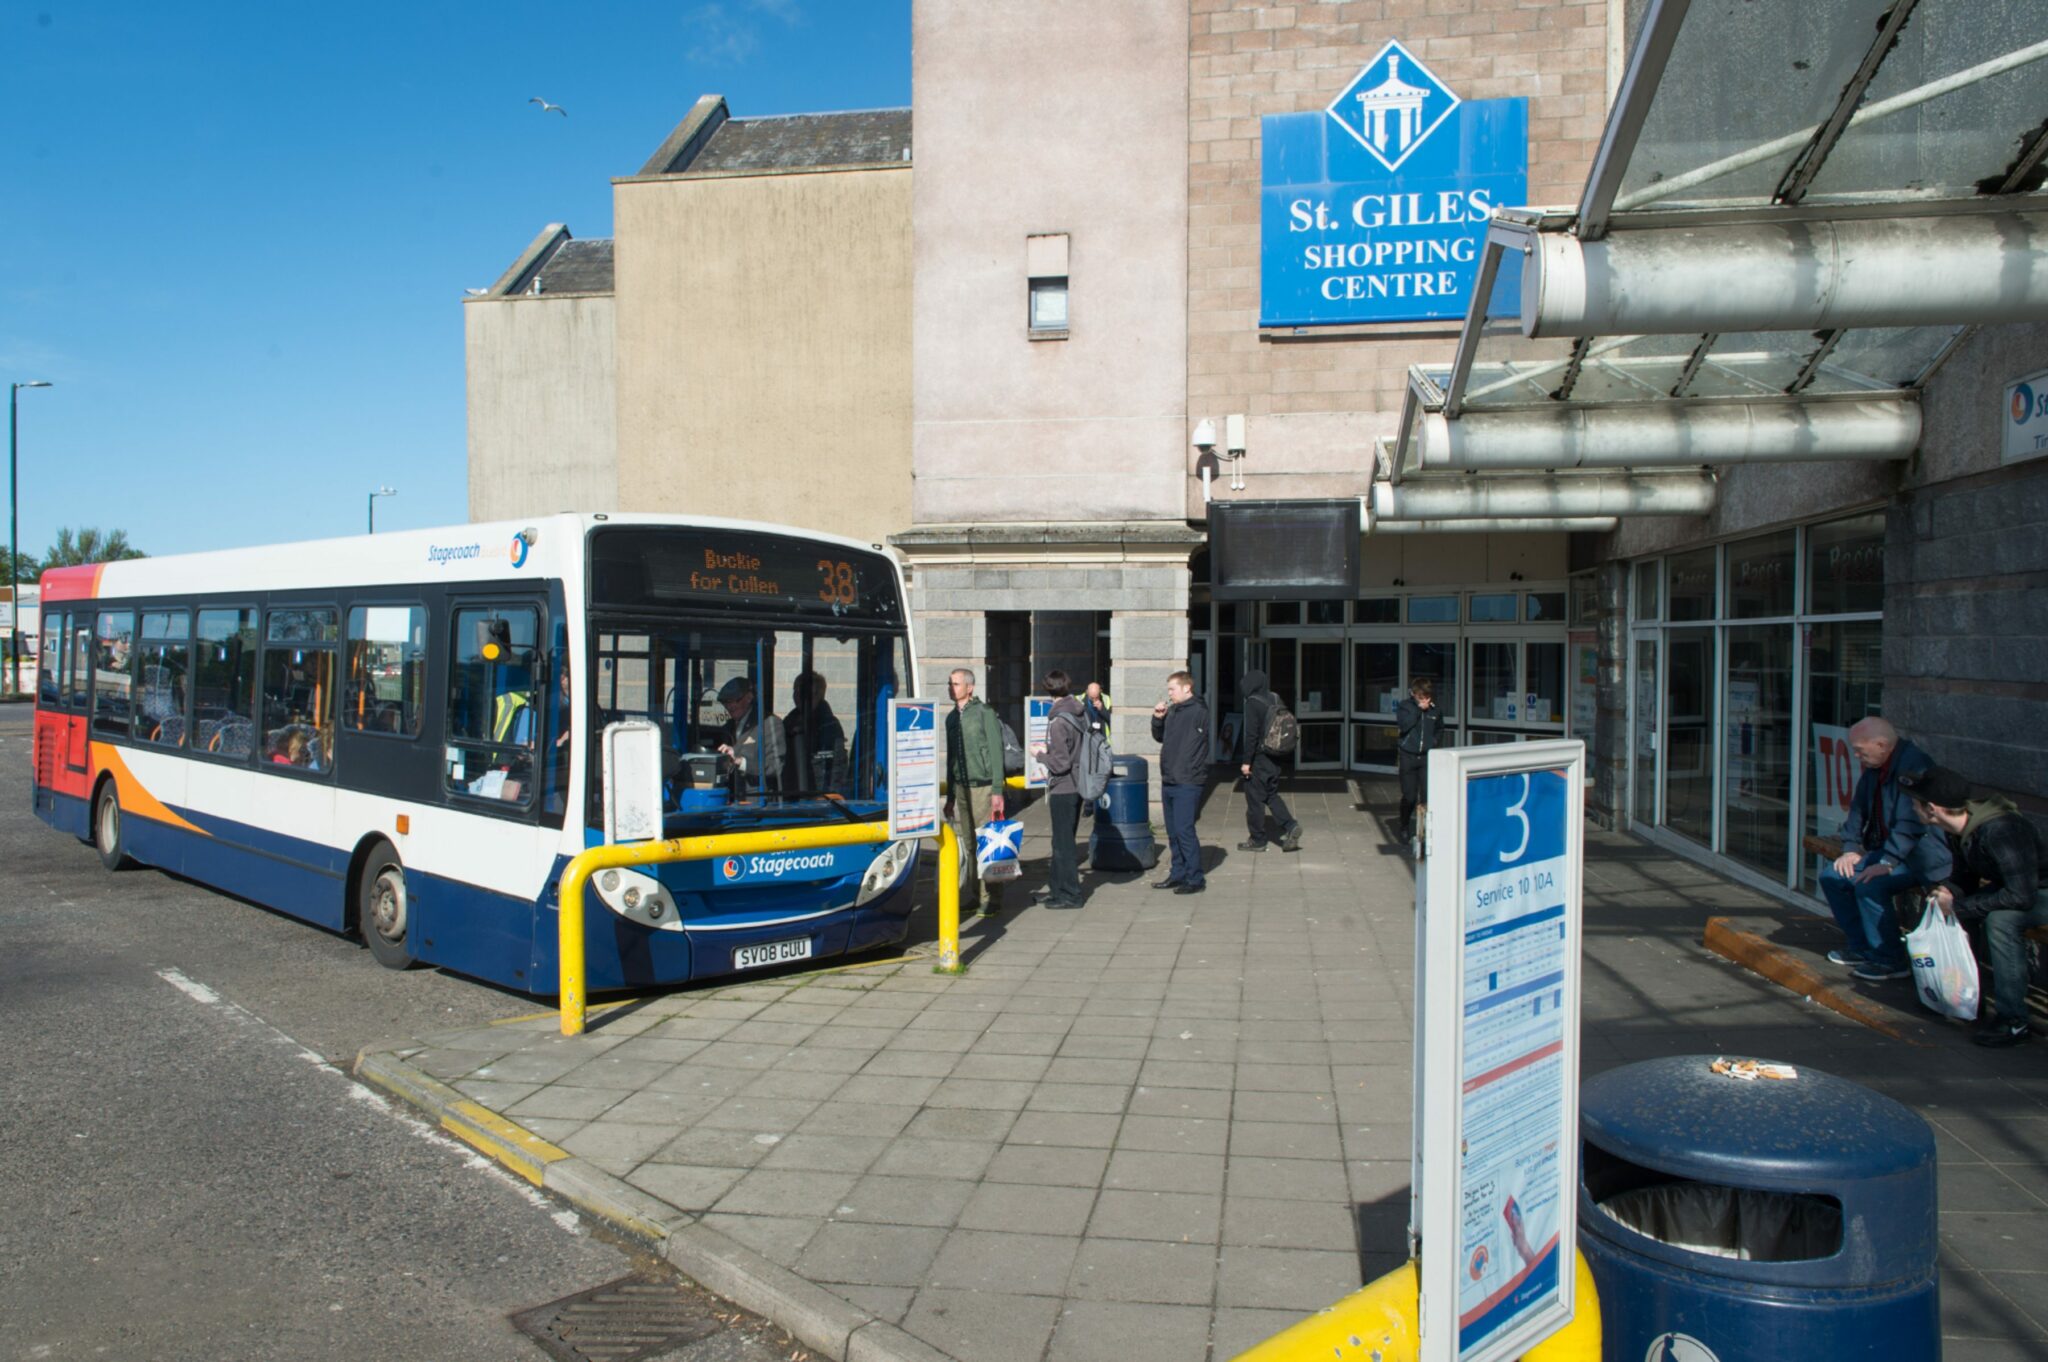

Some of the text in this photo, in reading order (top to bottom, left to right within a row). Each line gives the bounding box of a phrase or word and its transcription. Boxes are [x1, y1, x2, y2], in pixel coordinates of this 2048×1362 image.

[1289, 188, 1491, 232] St. GILES
[1303, 237, 1476, 270] SHOPPING
[1320, 271, 1458, 301] CENTRE
[428, 543, 480, 565] Stagecoach
[704, 548, 761, 571] Buckie
[689, 571, 780, 595] for Cullen
[816, 560, 855, 605] 38
[908, 706, 921, 730] 2
[1819, 735, 1853, 812] TO
[1499, 773, 1530, 863] 3
[749, 851, 834, 877] Stagecoach
[1476, 871, 1554, 908] Service 10 10A
[741, 940, 806, 965] SV08 GUU
